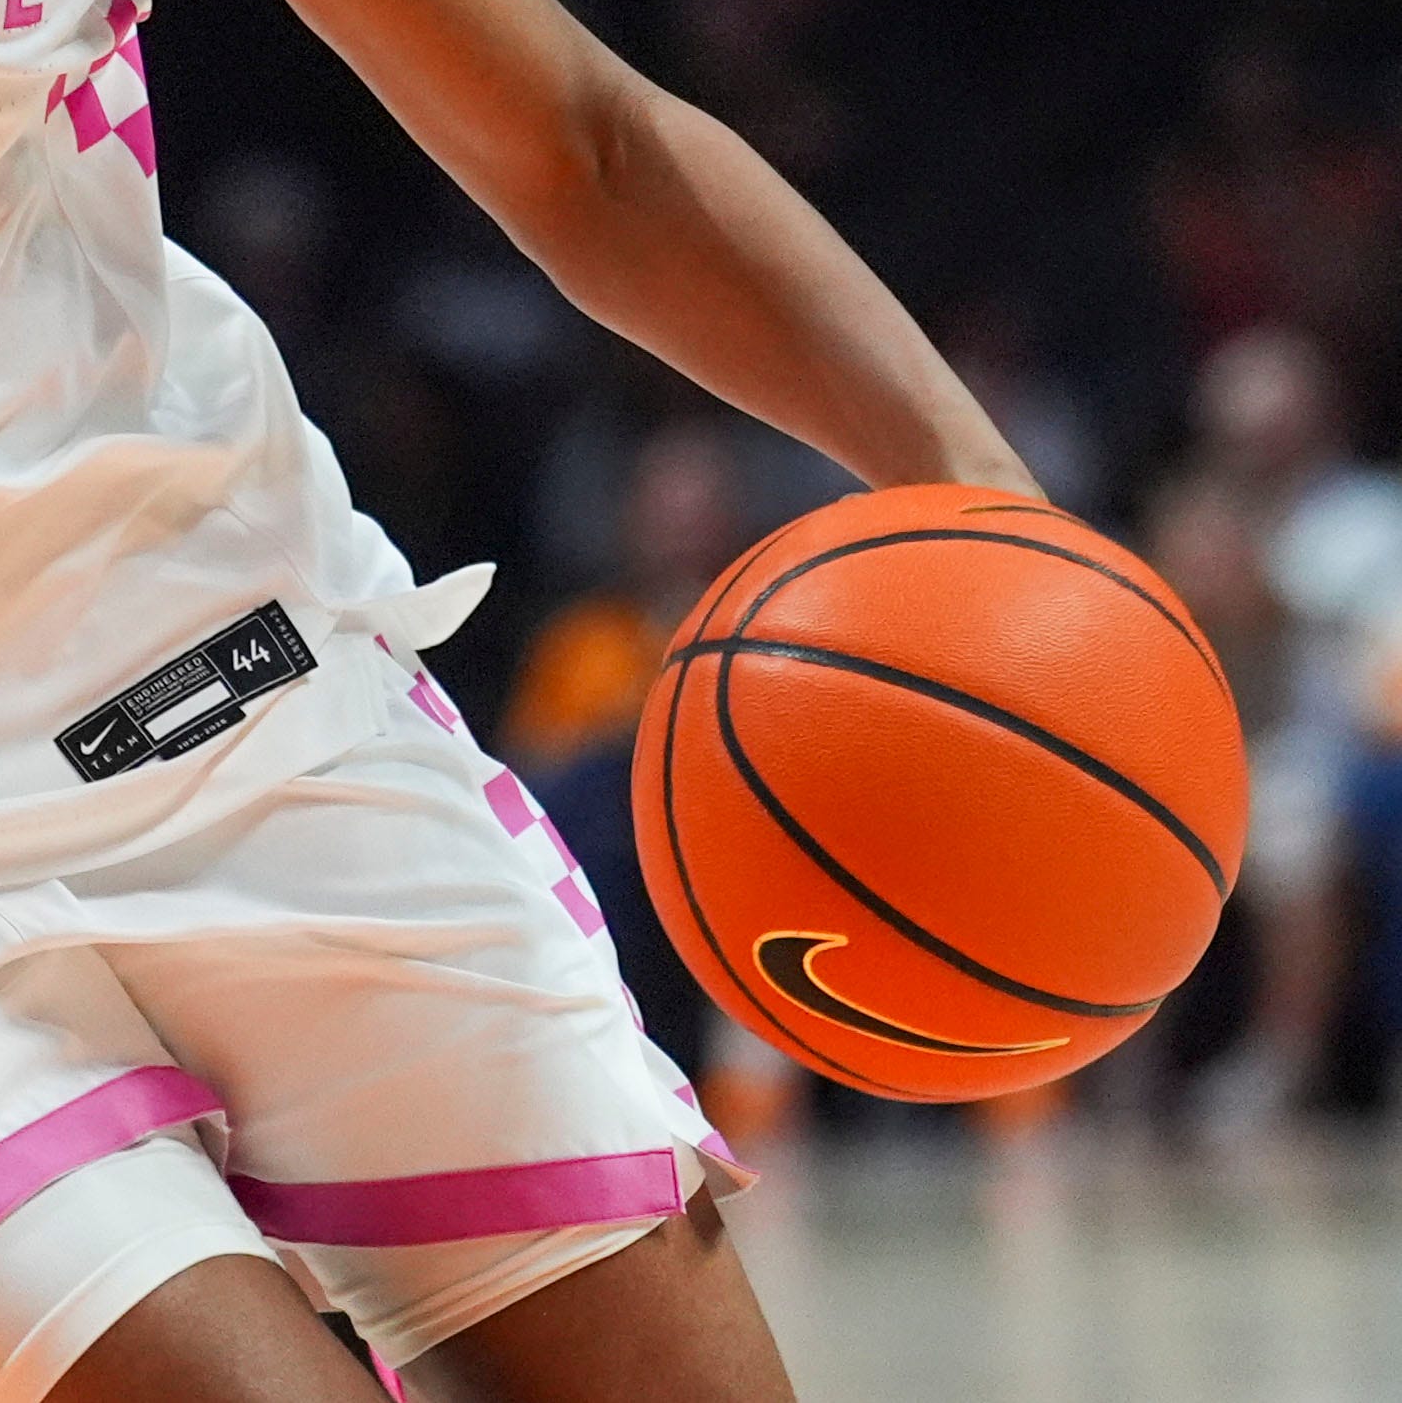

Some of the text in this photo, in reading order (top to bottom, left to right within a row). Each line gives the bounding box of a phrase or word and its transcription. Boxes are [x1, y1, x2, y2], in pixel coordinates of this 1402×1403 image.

[232, 638, 271, 672] 44
[126, 656, 203, 708] ENGINEERED
[91, 734, 139, 770] TEAM
